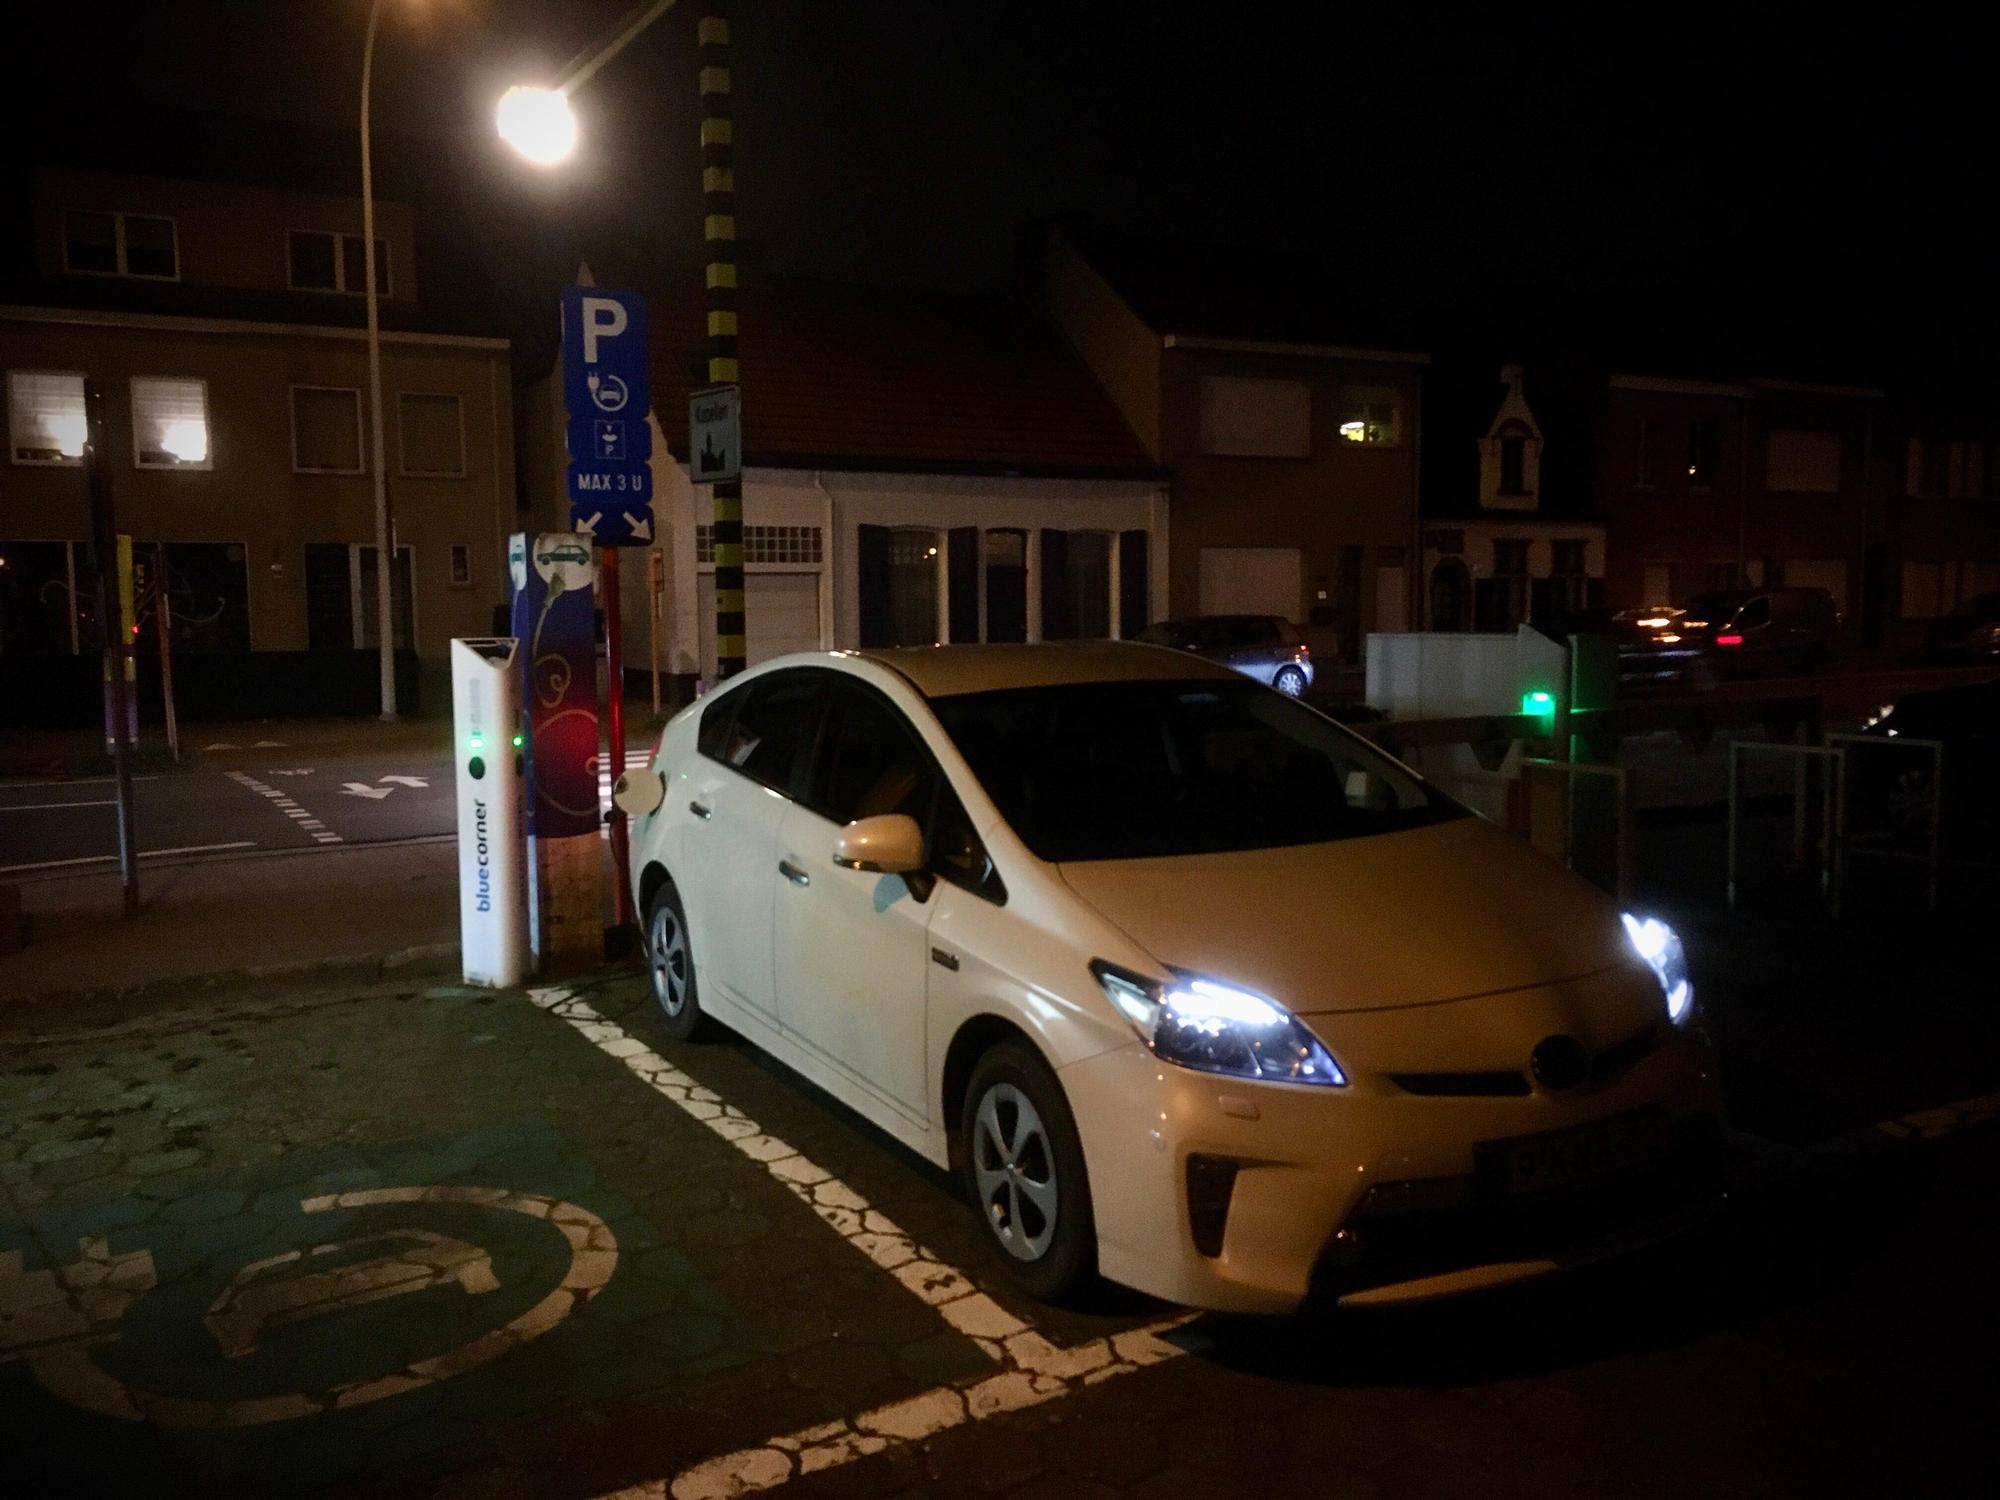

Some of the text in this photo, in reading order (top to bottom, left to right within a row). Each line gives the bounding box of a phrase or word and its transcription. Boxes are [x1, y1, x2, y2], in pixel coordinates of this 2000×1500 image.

[582, 297, 628, 363] P
[605, 444, 615, 456] P
[577, 473, 643, 492] MAX 3 U
[474, 798, 490, 912] bluecorner
